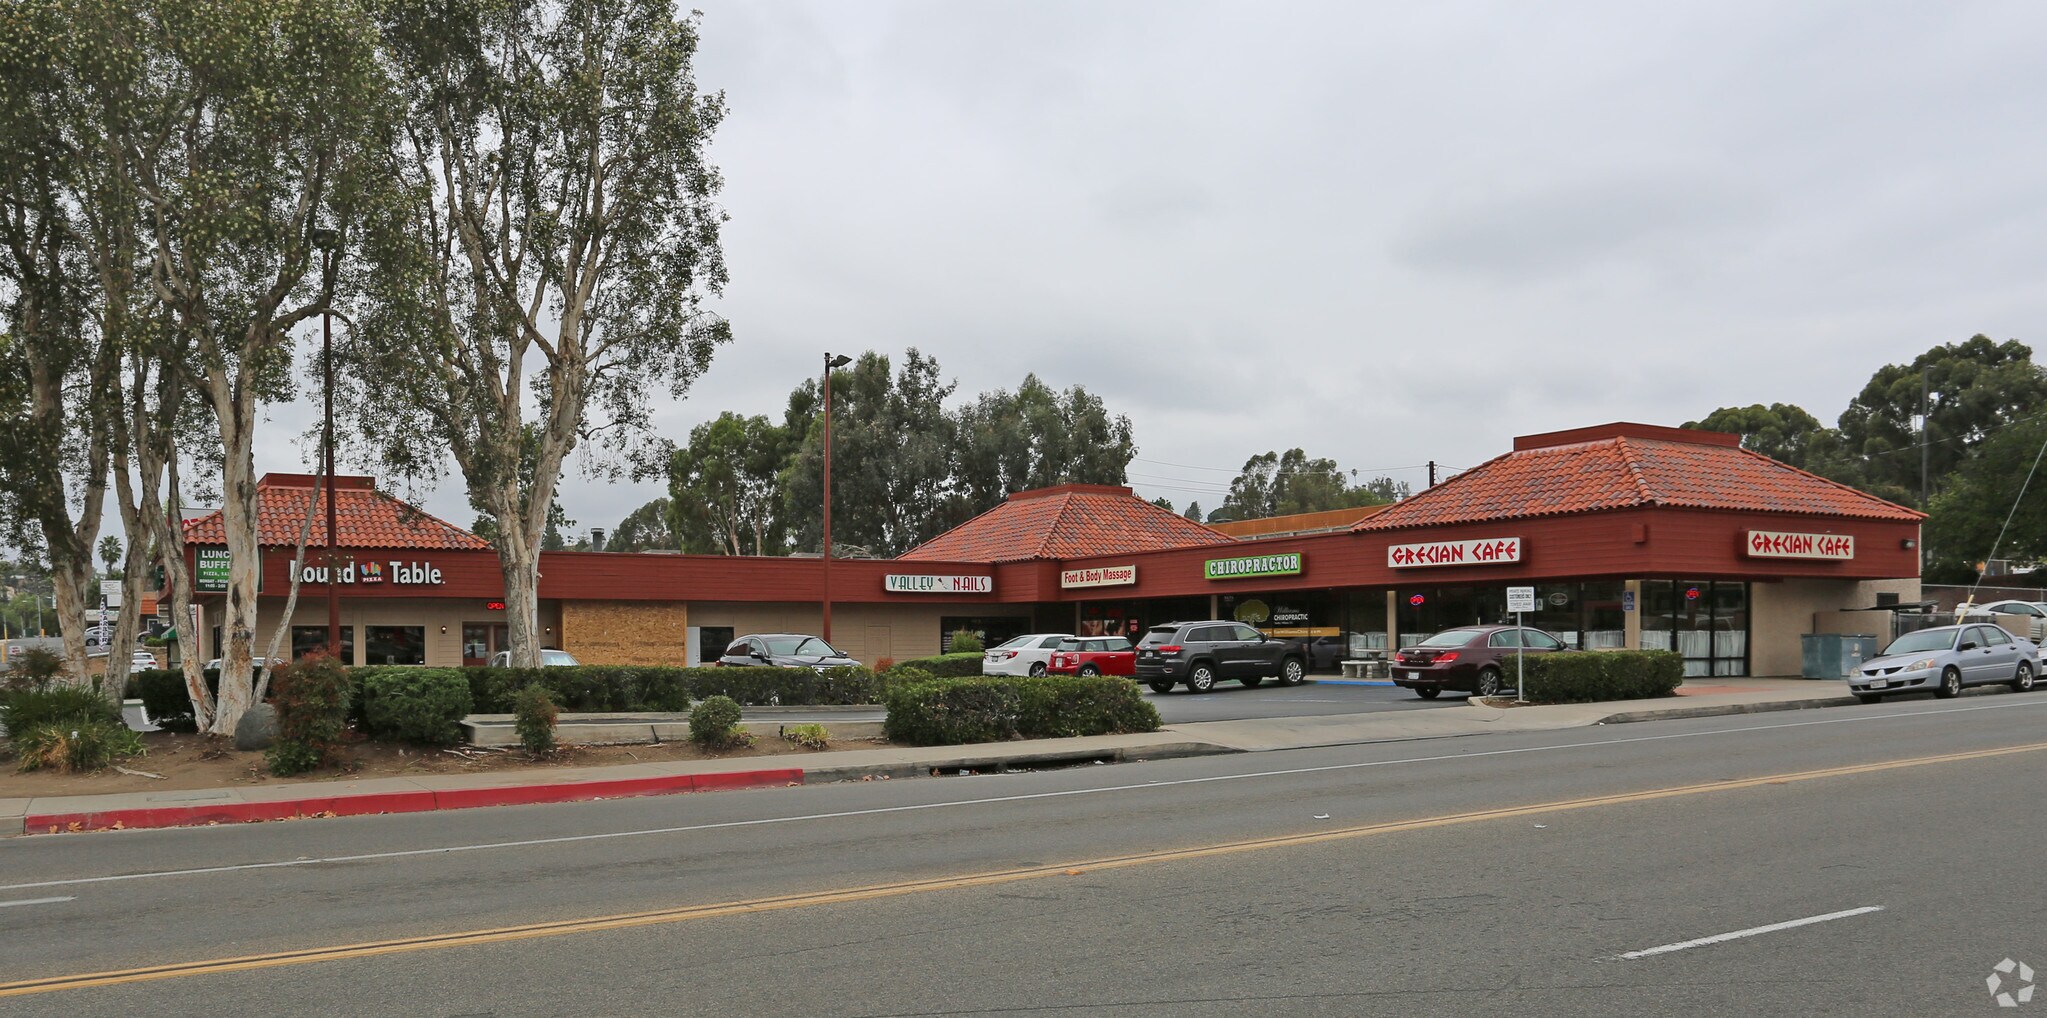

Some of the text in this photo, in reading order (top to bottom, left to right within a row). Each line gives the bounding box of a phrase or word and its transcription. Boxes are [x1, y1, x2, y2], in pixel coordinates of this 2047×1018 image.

[1751, 533, 1850, 556] GRECIAN CAFE
[201, 550, 230, 558] LUNC
[1391, 540, 1516, 565] GRECIAN CAFE
[200, 560, 231, 569] BUFFE
[1209, 555, 1298, 575] CHIROPRACTOR
[1065, 568, 1132, 583] Foot & Body Massage
[890, 576, 986, 591] VALLEY NAILS
[1410, 596, 1424, 604] OPEN
[1274, 613, 1308, 621] CHIROPRACTIC
